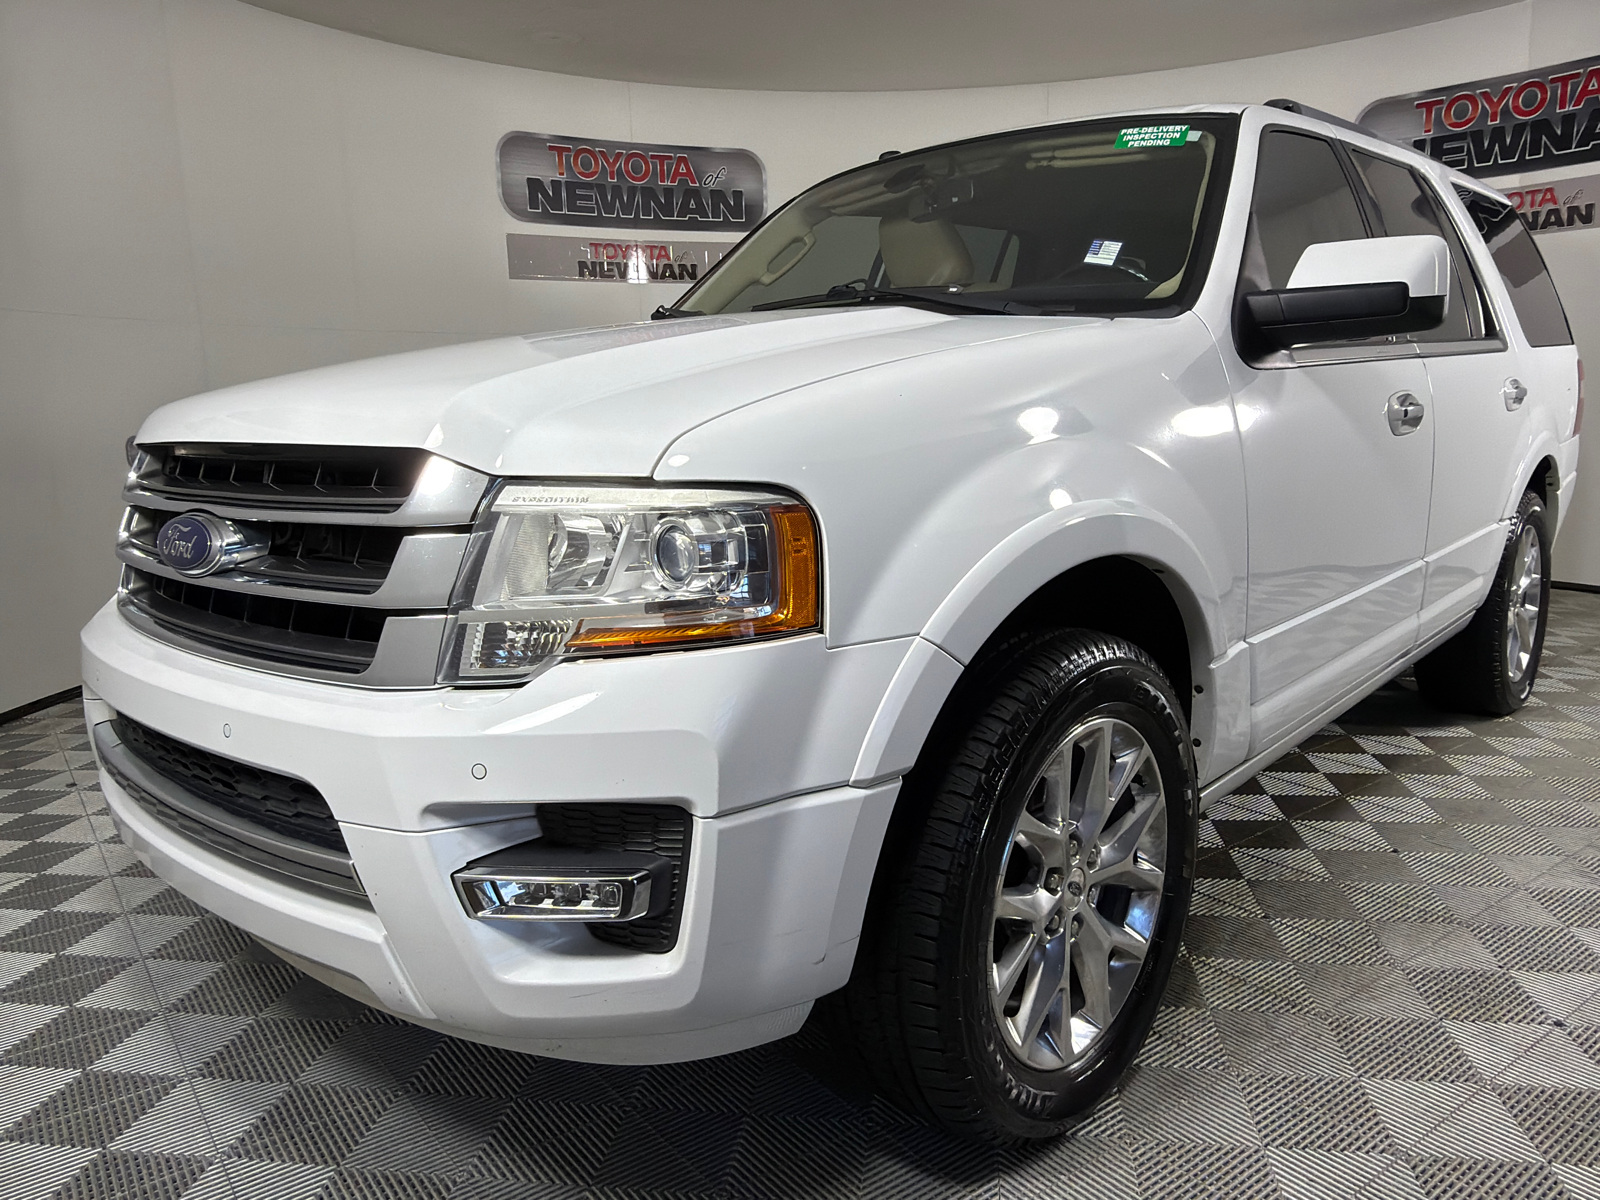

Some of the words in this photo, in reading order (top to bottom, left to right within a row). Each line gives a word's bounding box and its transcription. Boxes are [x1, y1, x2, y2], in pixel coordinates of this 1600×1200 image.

[1120, 125, 1188, 135] PRE-DELIVERY
[1122, 132, 1180, 141] INSPECTION
[1127, 139, 1171, 147] PENDING
[547, 143, 699, 186] TOYOTA
[702, 167, 727, 187] of
[526, 177, 745, 221] NEWNAN
[163, 523, 198, 559] Ford
